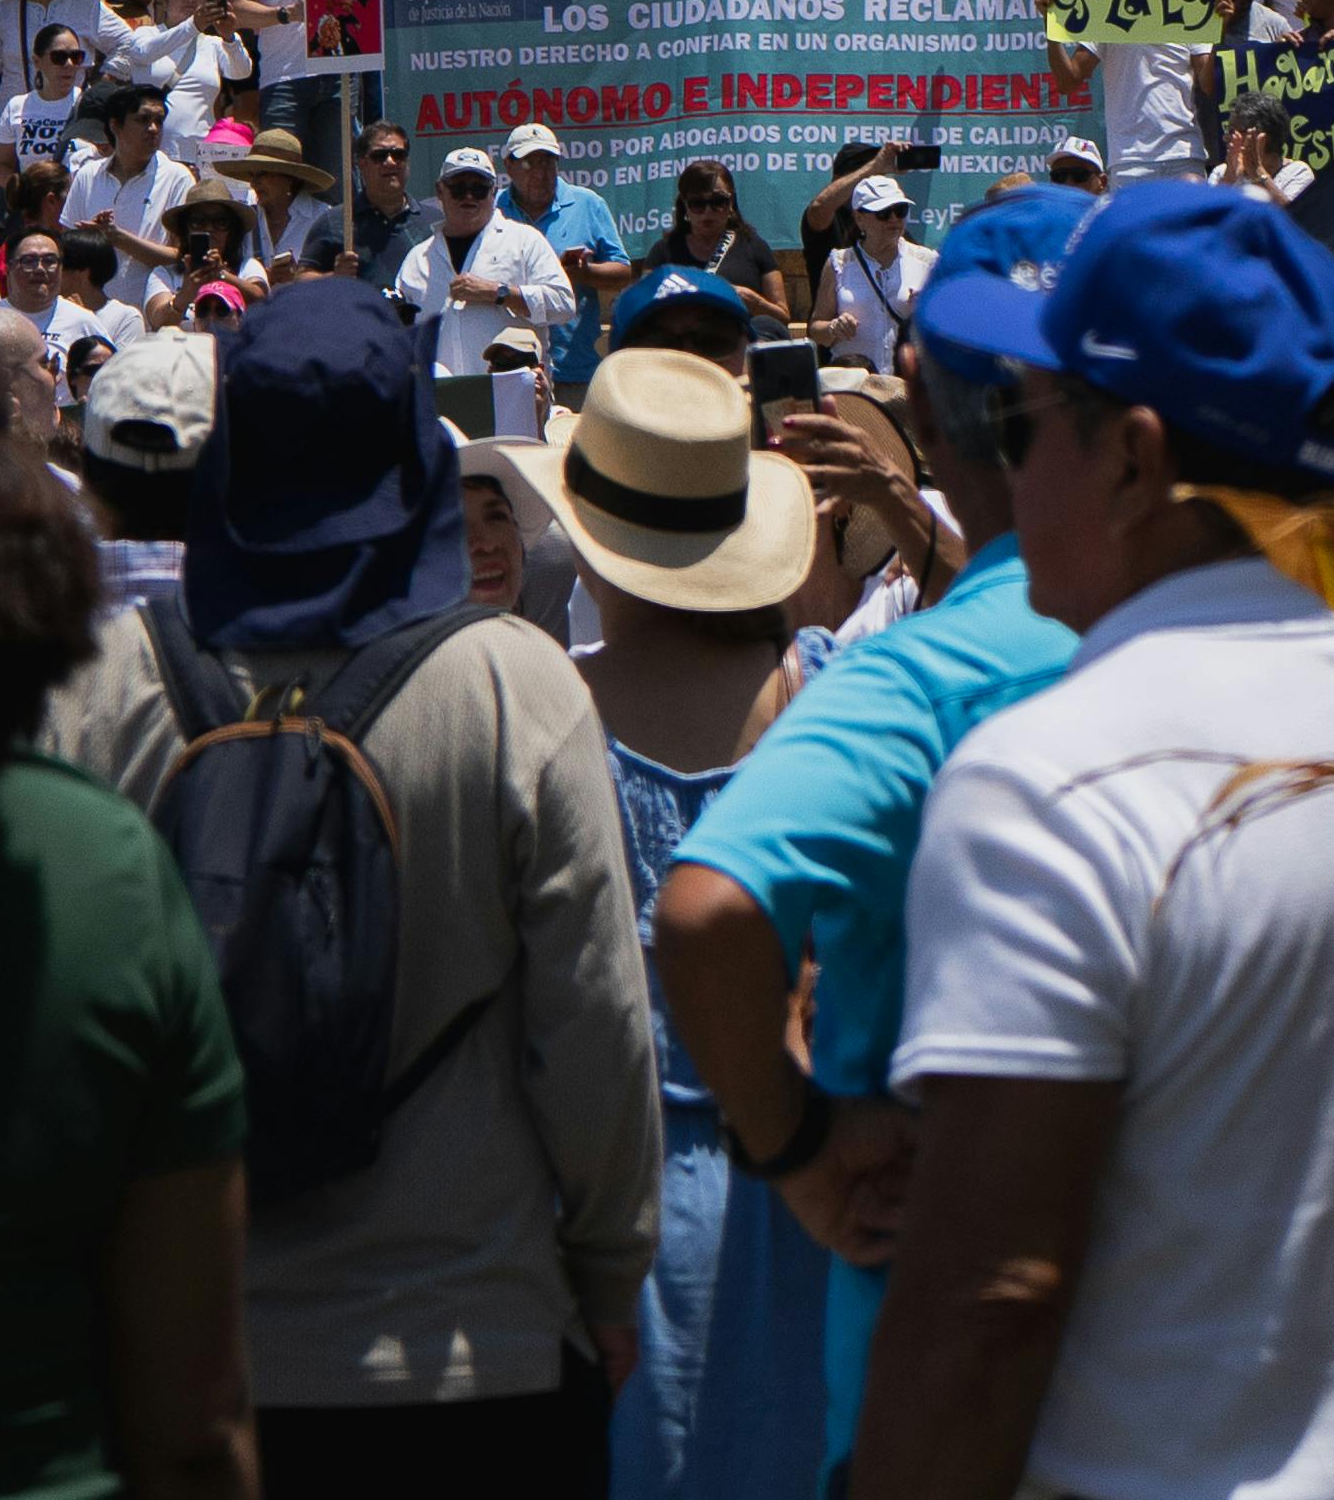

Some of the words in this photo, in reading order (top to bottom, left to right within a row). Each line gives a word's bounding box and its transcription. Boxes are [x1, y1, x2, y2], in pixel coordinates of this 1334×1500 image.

[543, 4, 609, 33] LOS
[410, 48, 513, 71] NUESTRO
[519, 43, 629, 66] DERECHO
[635, 42, 652, 60] A
[657, 33, 751, 60] CONFIAR
[758, 33, 788, 51] EN
[795, 33, 827, 51] UN
[834, 33, 978, 52] ORGANISMO
[984, 31, 1049, 52] JUDIC
[415, 78, 672, 131] AUTÓNOMO
[682, 76, 710, 113] E
[610, 136, 654, 158] POR
[659, 125, 781, 151] ABOGADOS
[788, 125, 836, 144] CON
[844, 125, 925, 146] PERFIL
[933, 126, 963, 145] DE
[969, 125, 1068, 146] CALIDAD
[615, 165, 642, 186] EN
[767, 153, 797, 171] DE
[940, 155, 1046, 174] MEXICAN
